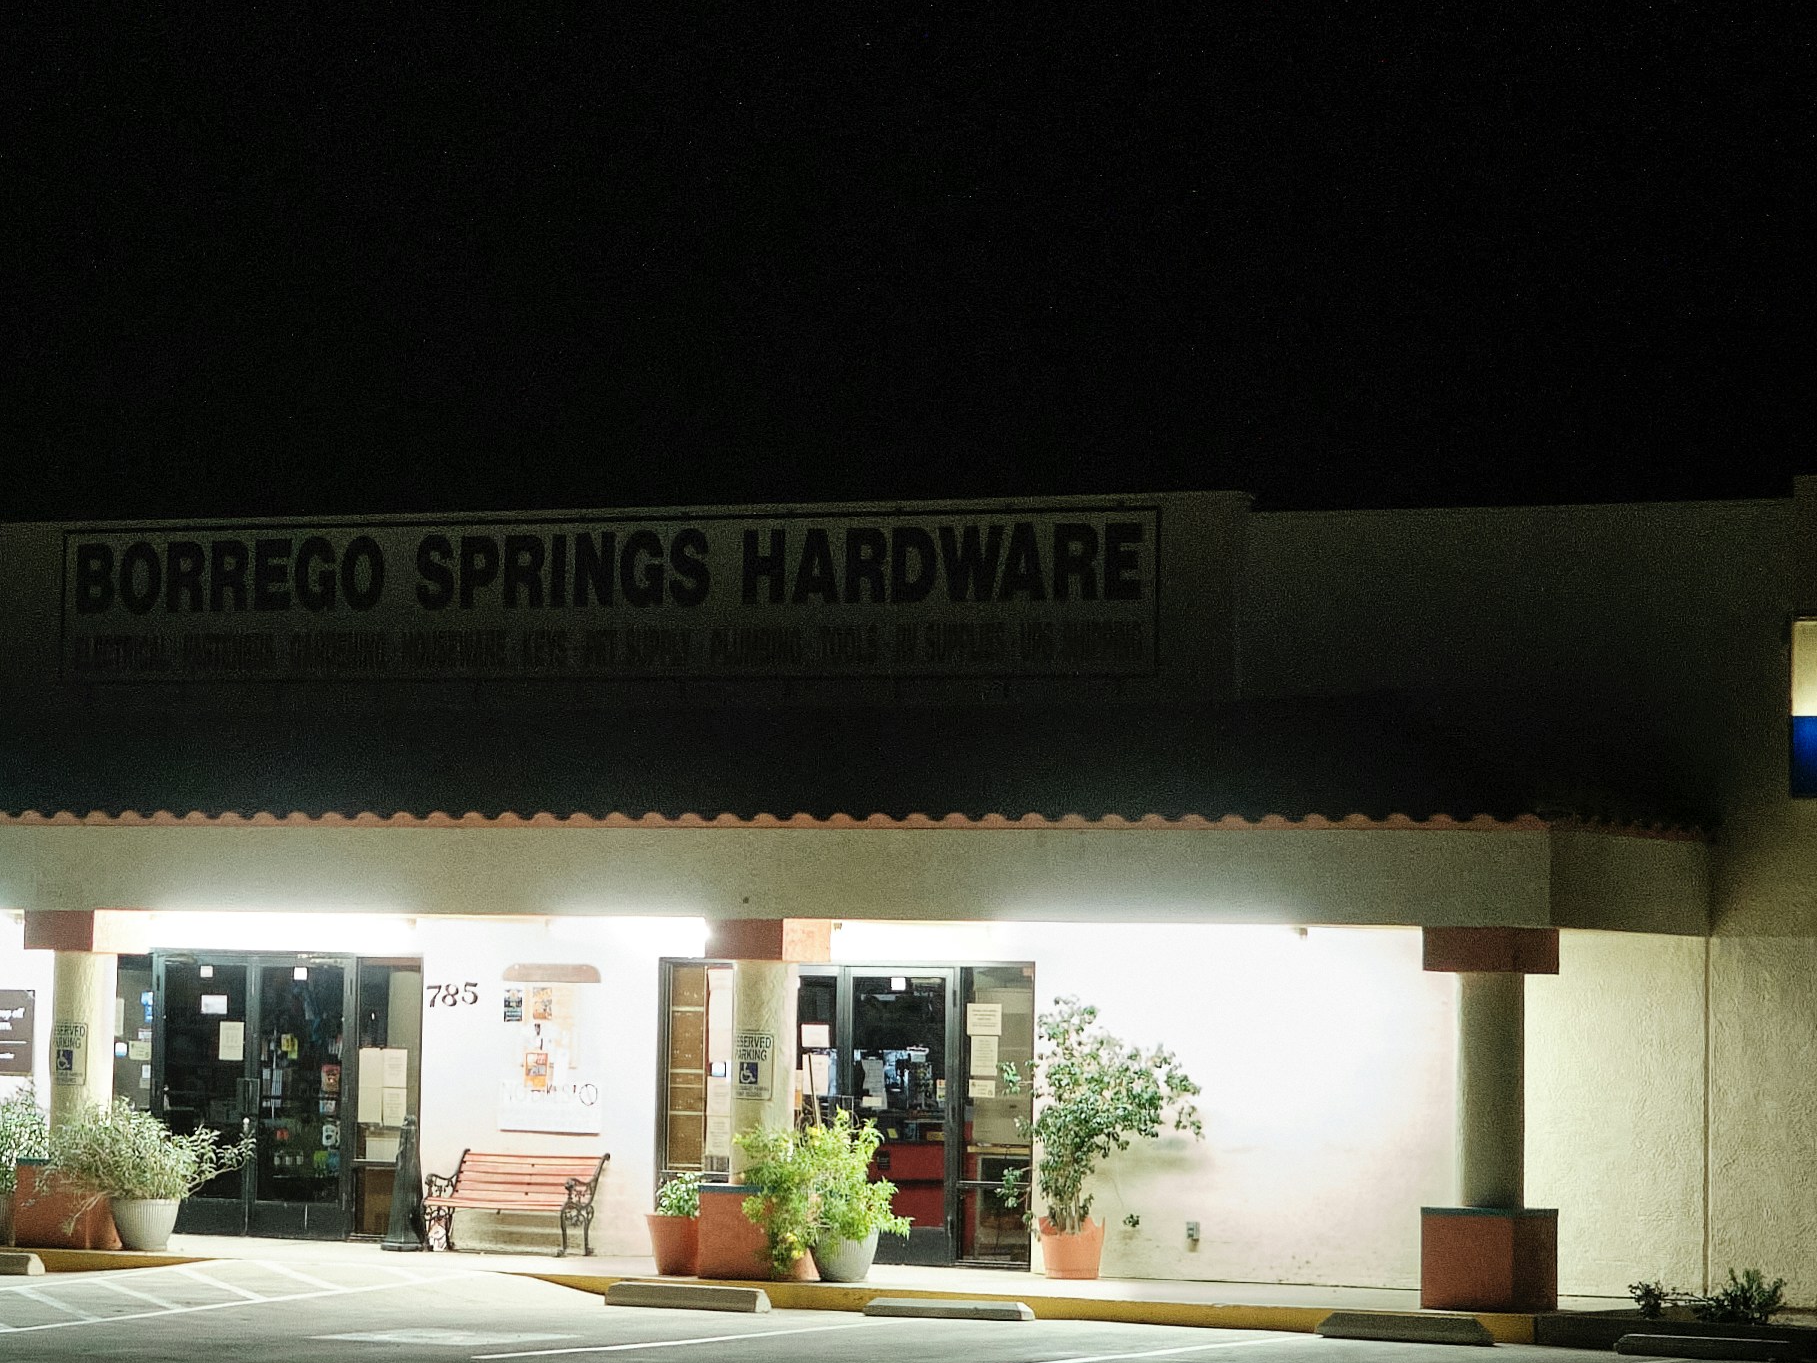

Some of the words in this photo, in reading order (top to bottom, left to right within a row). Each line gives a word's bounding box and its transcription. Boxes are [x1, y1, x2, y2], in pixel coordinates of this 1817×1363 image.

[75, 534, 385, 614] BORREGO
[415, 528, 711, 611] SPRINGS
[742, 522, 1143, 605] HARDWARE
[522, 629, 568, 668] KEYS
[819, 625, 878, 665] TOOLS
[426, 982, 479, 1008] 785
